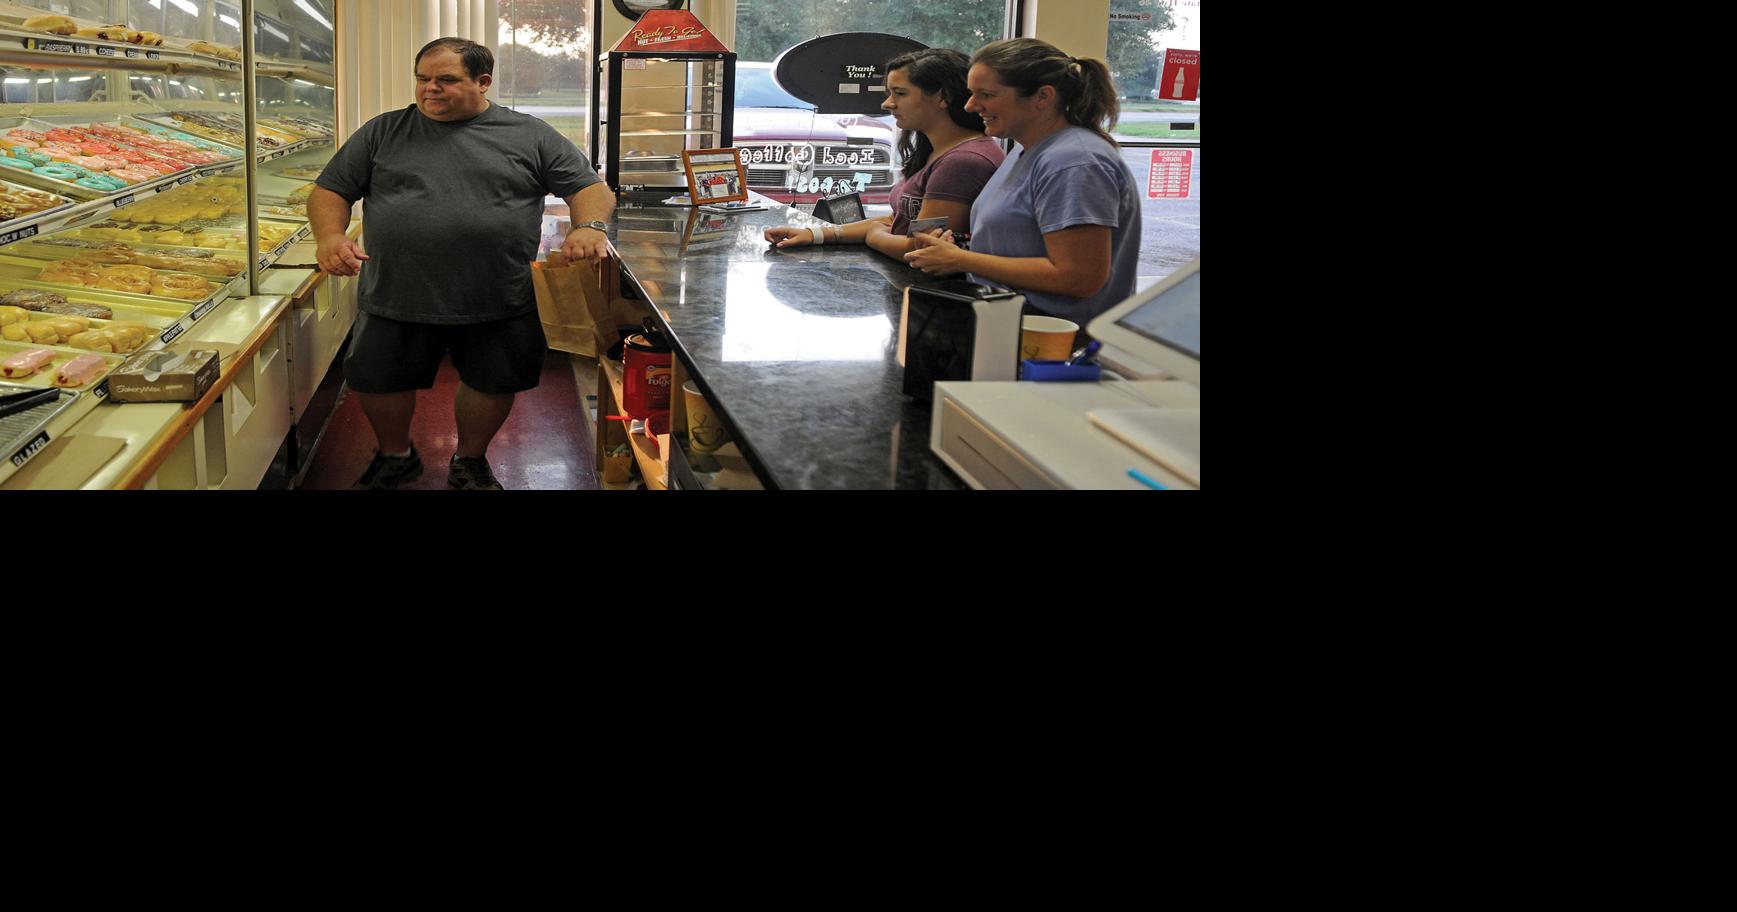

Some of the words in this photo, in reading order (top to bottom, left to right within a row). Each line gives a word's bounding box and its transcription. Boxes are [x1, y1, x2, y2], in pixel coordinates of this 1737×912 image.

[632, 27, 664, 41] Ready
[664, 25, 678, 35] To
[1169, 57, 1197, 65] closed
[20, 227, 35, 239] NUTS
[13, 437, 46, 465] GLAZED
